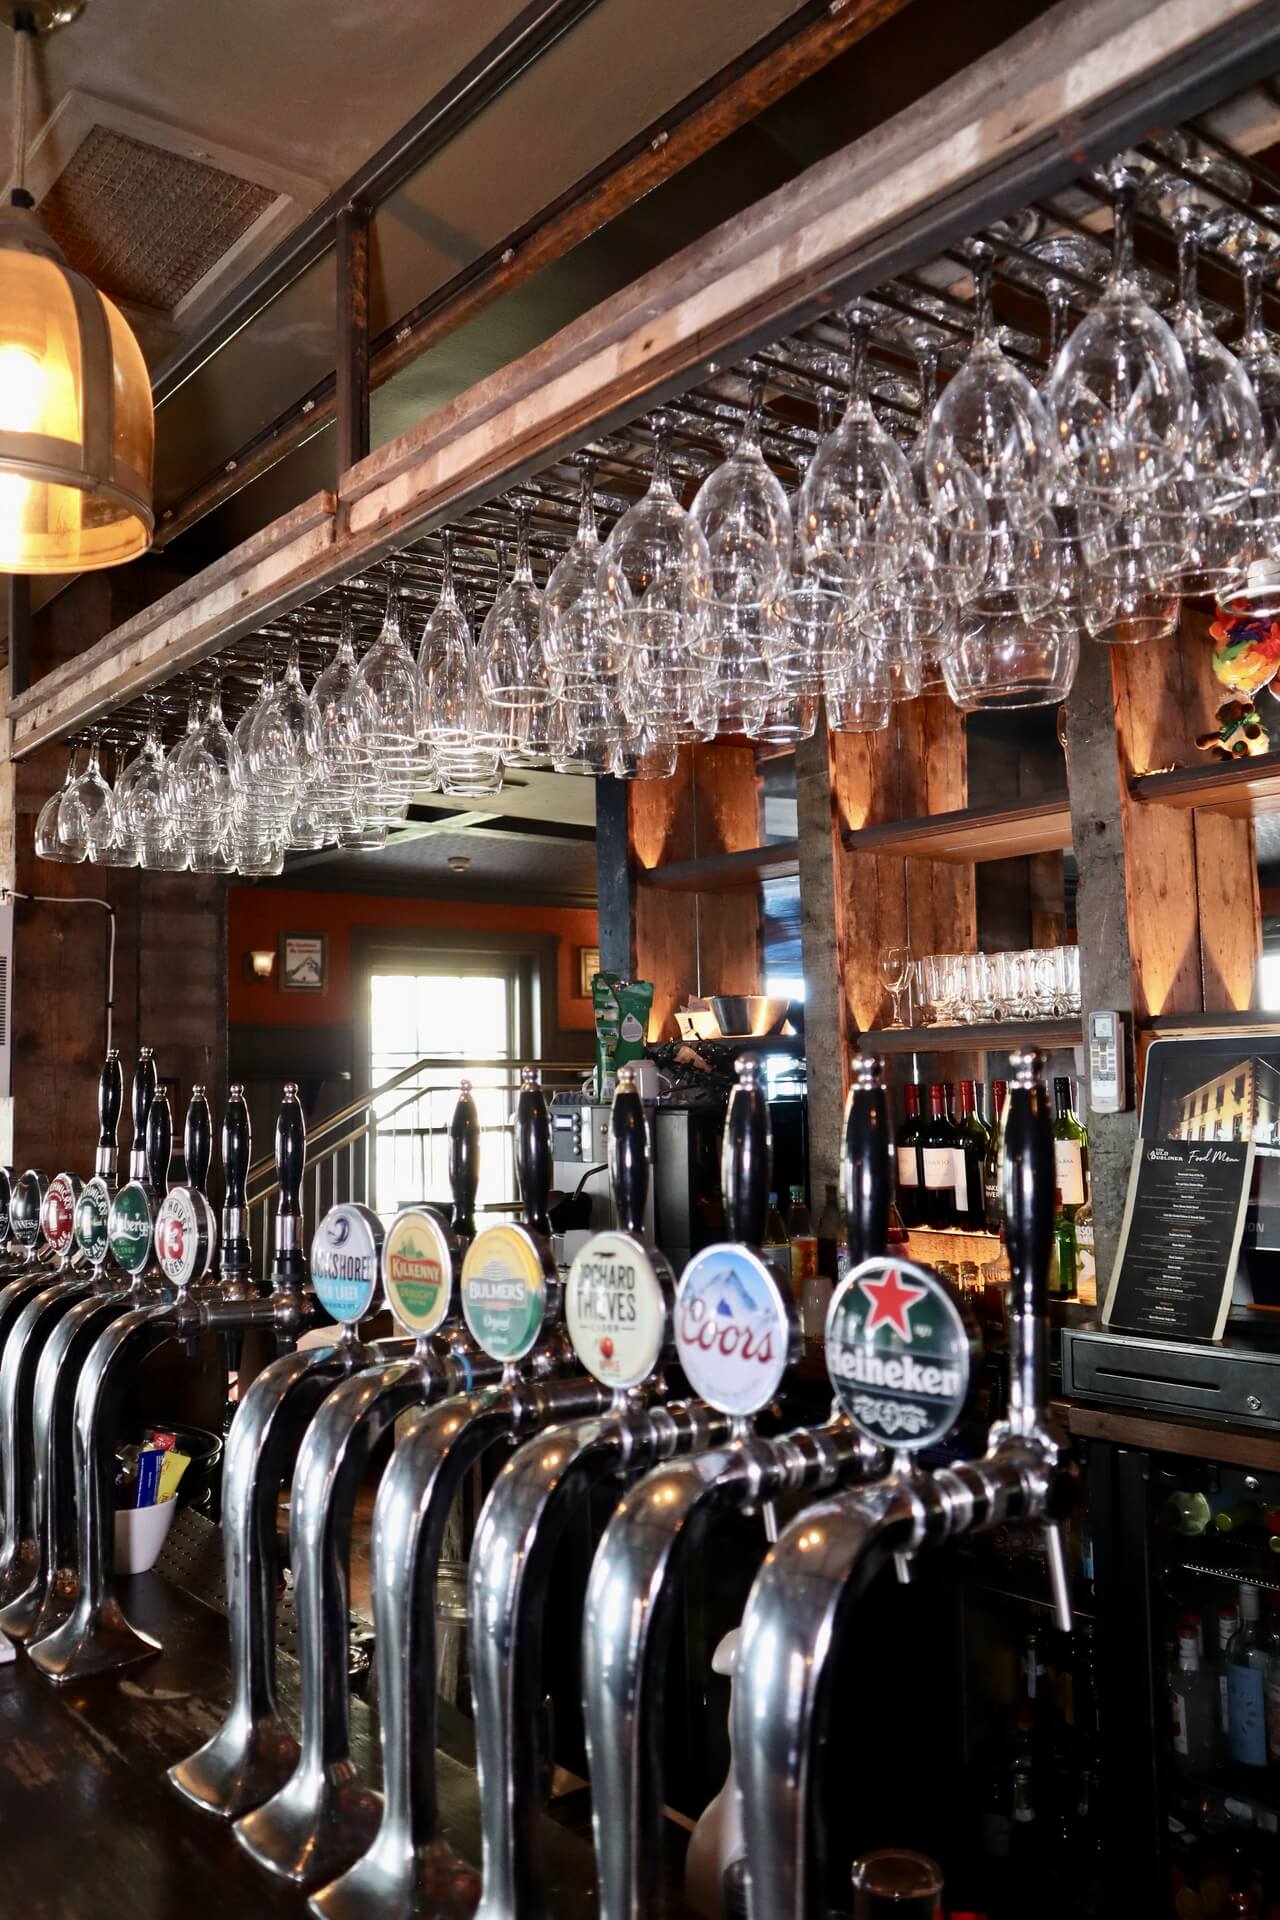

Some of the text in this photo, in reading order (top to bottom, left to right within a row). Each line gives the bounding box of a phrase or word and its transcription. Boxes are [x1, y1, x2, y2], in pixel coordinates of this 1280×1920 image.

[1188, 1147, 1240, 1164] Food Menu
[392, 1257, 441, 1282] KILKENNY
[469, 1280, 525, 1301] BULMERS
[681, 1297, 774, 1364] Coors
[830, 1342, 961, 1397] Heineken
